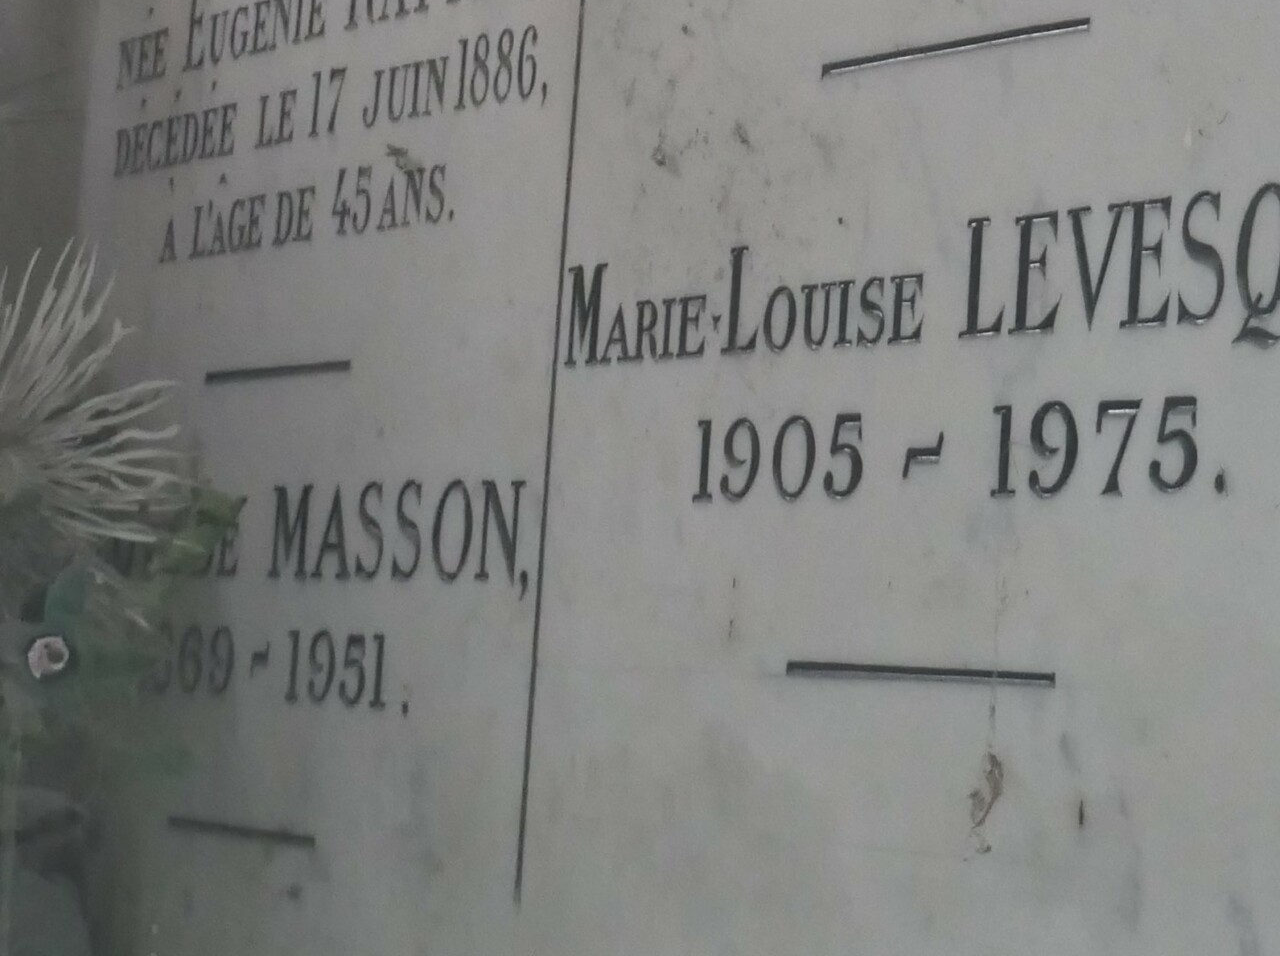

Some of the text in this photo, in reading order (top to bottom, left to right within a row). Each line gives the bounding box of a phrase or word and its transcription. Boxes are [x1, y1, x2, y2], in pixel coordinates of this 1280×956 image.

[254, 89, 298, 150] LE
[308, 66, 348, 138] 17
[362, 55, 449, 128] JUIN
[454, 24, 548, 113] 1886,
[271, 185, 316, 250] DE
[692, 412, 866, 504] 1905
[989, 395, 1228, 499] 1975.
[266, 478, 529, 602] MASSON,
[284, 628, 410, 717] 1951.
